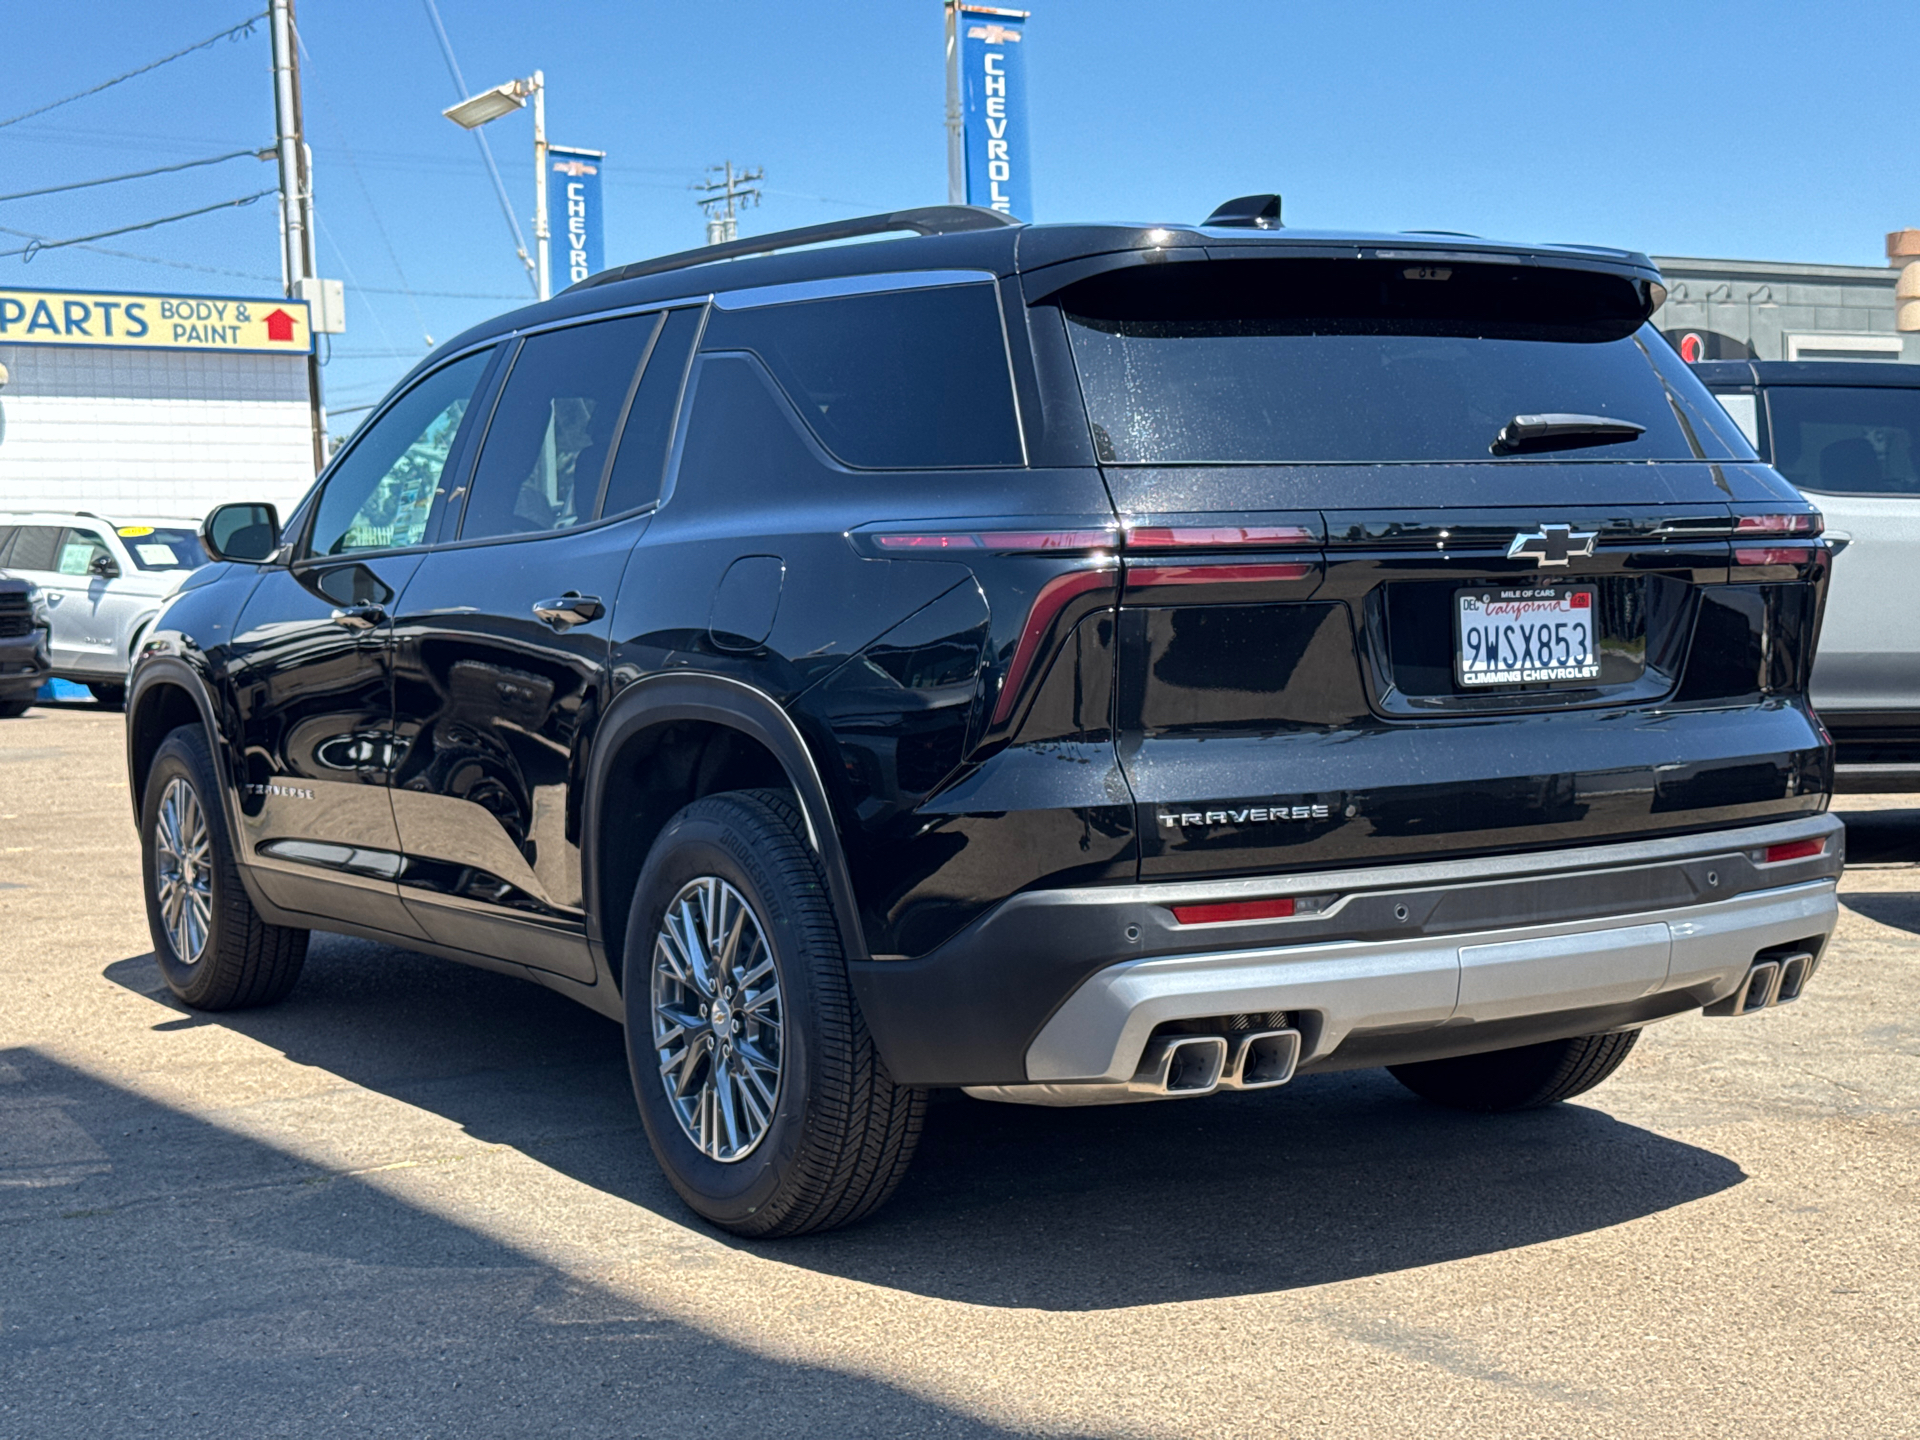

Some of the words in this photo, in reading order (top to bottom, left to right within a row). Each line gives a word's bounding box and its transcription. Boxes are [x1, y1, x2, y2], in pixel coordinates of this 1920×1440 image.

[0, 298, 149, 338] PARTS
[161, 301, 227, 321] BODY
[236, 302, 250, 323] &
[173, 323, 241, 344] PAINT
[1501, 590, 1521, 598] MILE
[1522, 590, 1534, 598] OF
[1535, 589, 1555, 597] CARS
[1463, 599, 1479, 611] DEC
[1467, 623, 1588, 669] 9WSX853
[1464, 670, 1522, 684] CUMMING
[1523, 666, 1599, 681] CHEVROLET
[1159, 804, 1328, 827] TRAVERSE
